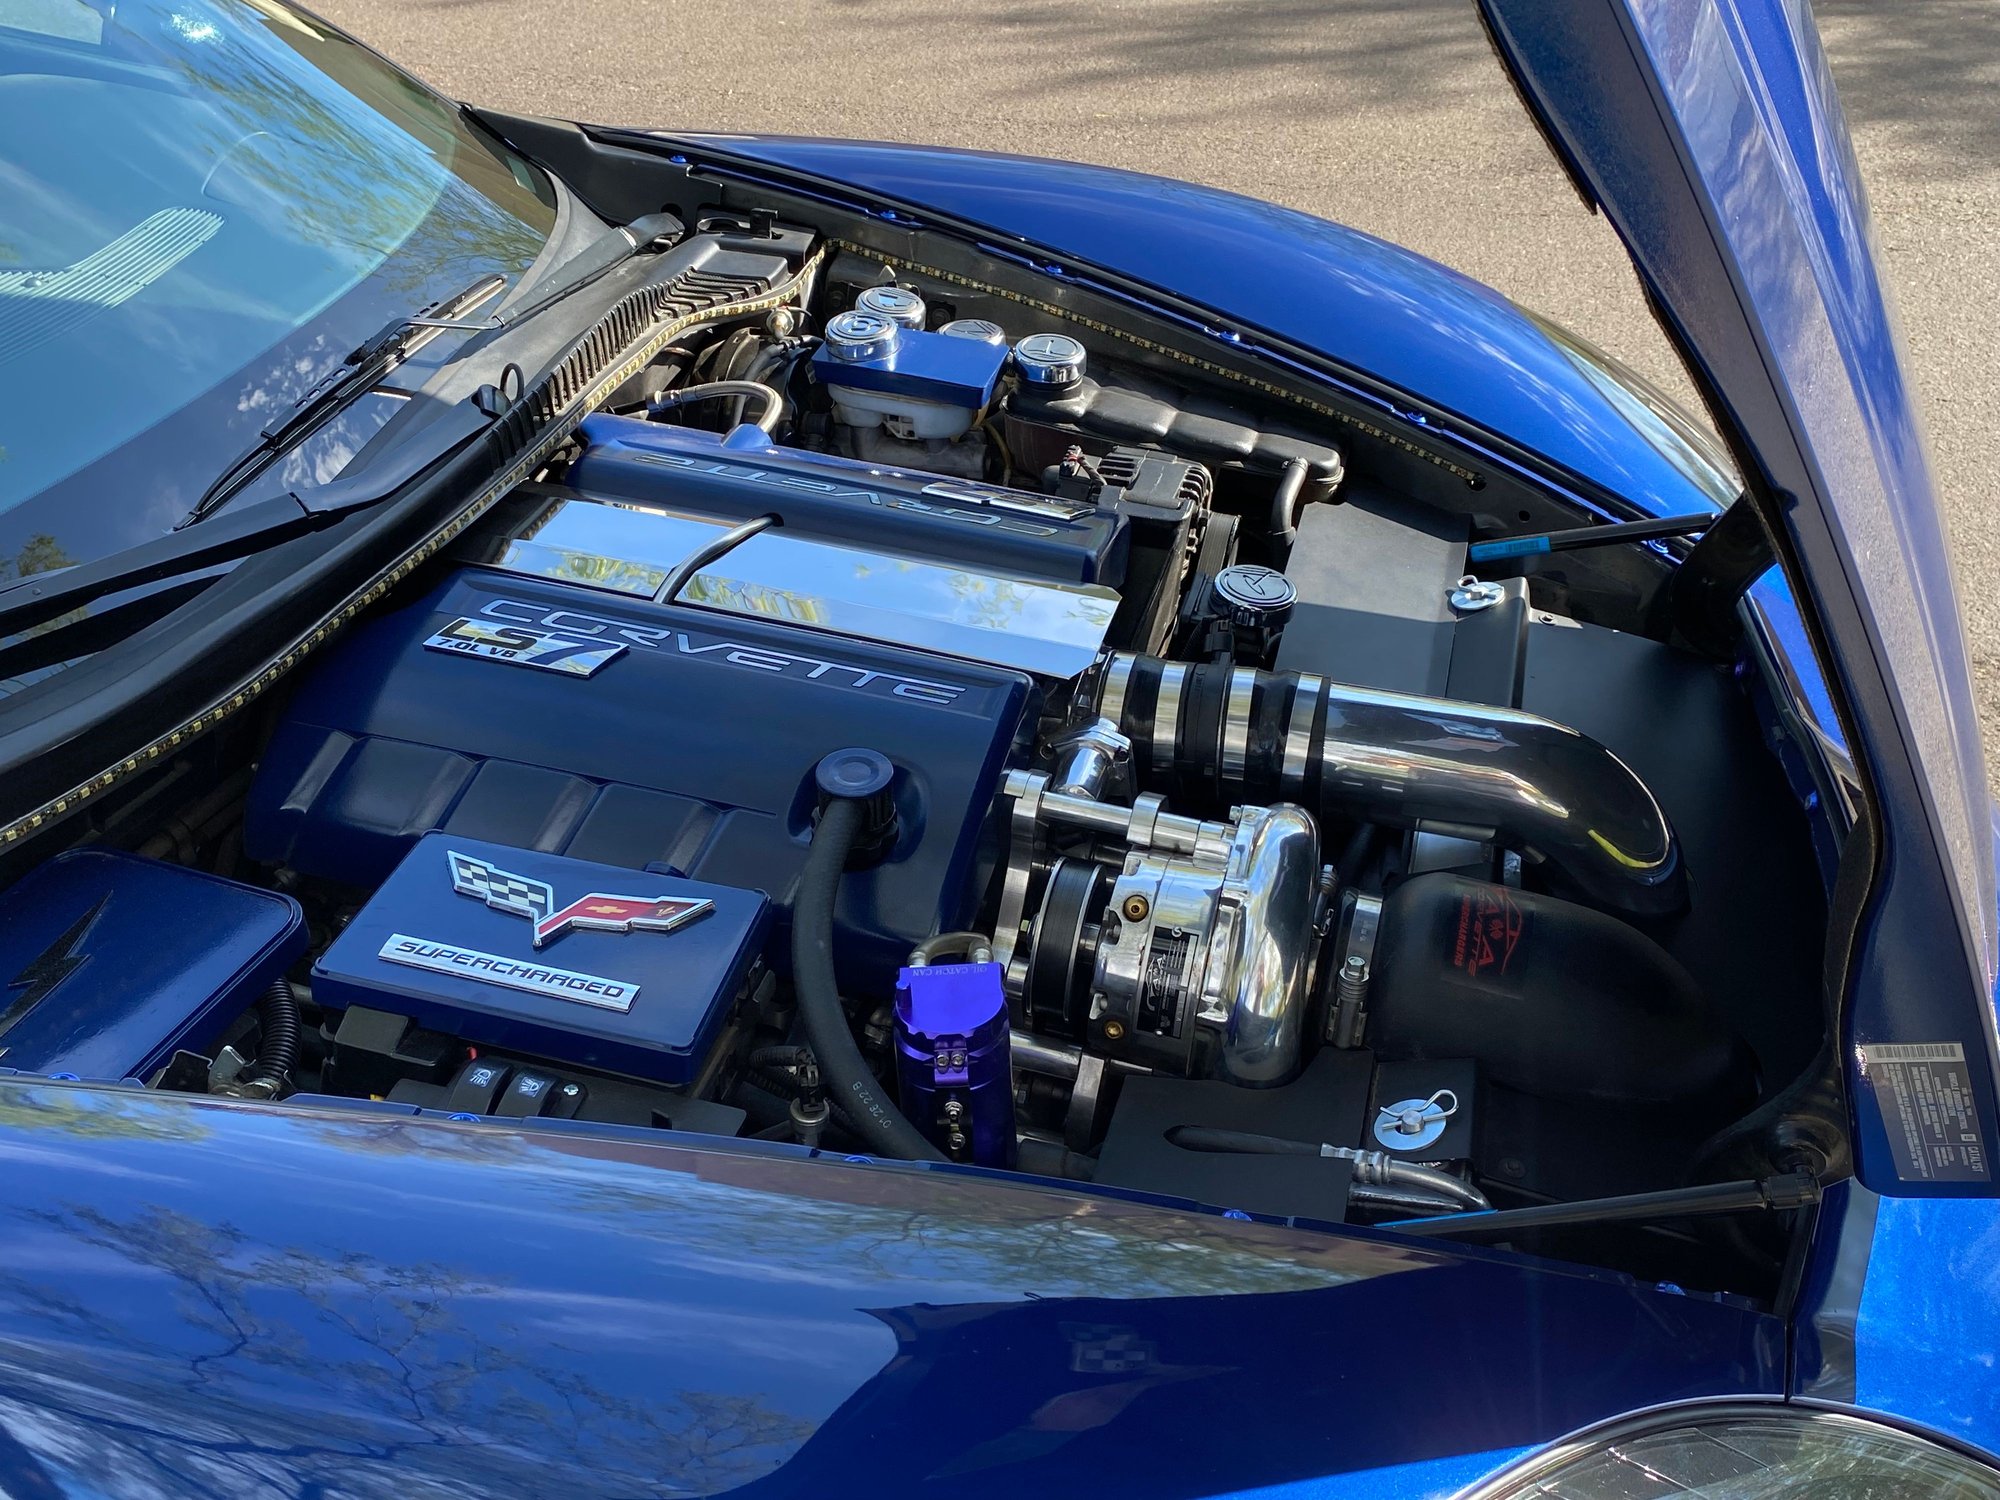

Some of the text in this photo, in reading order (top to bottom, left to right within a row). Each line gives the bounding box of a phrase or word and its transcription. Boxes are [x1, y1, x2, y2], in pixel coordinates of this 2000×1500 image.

[634, 453, 1058, 537] CORVETTE
[437, 619, 622, 666] LS7
[437, 639, 518, 658] 7.0L V8
[480, 598, 967, 705] CORVETTE
[395, 940, 625, 999] SUPERCHARGED
[912, 966, 988, 977] OIL CATCH CAN
[858, 1089, 873, 1105] 22
[1968, 1146, 1984, 1173] CATALYST
